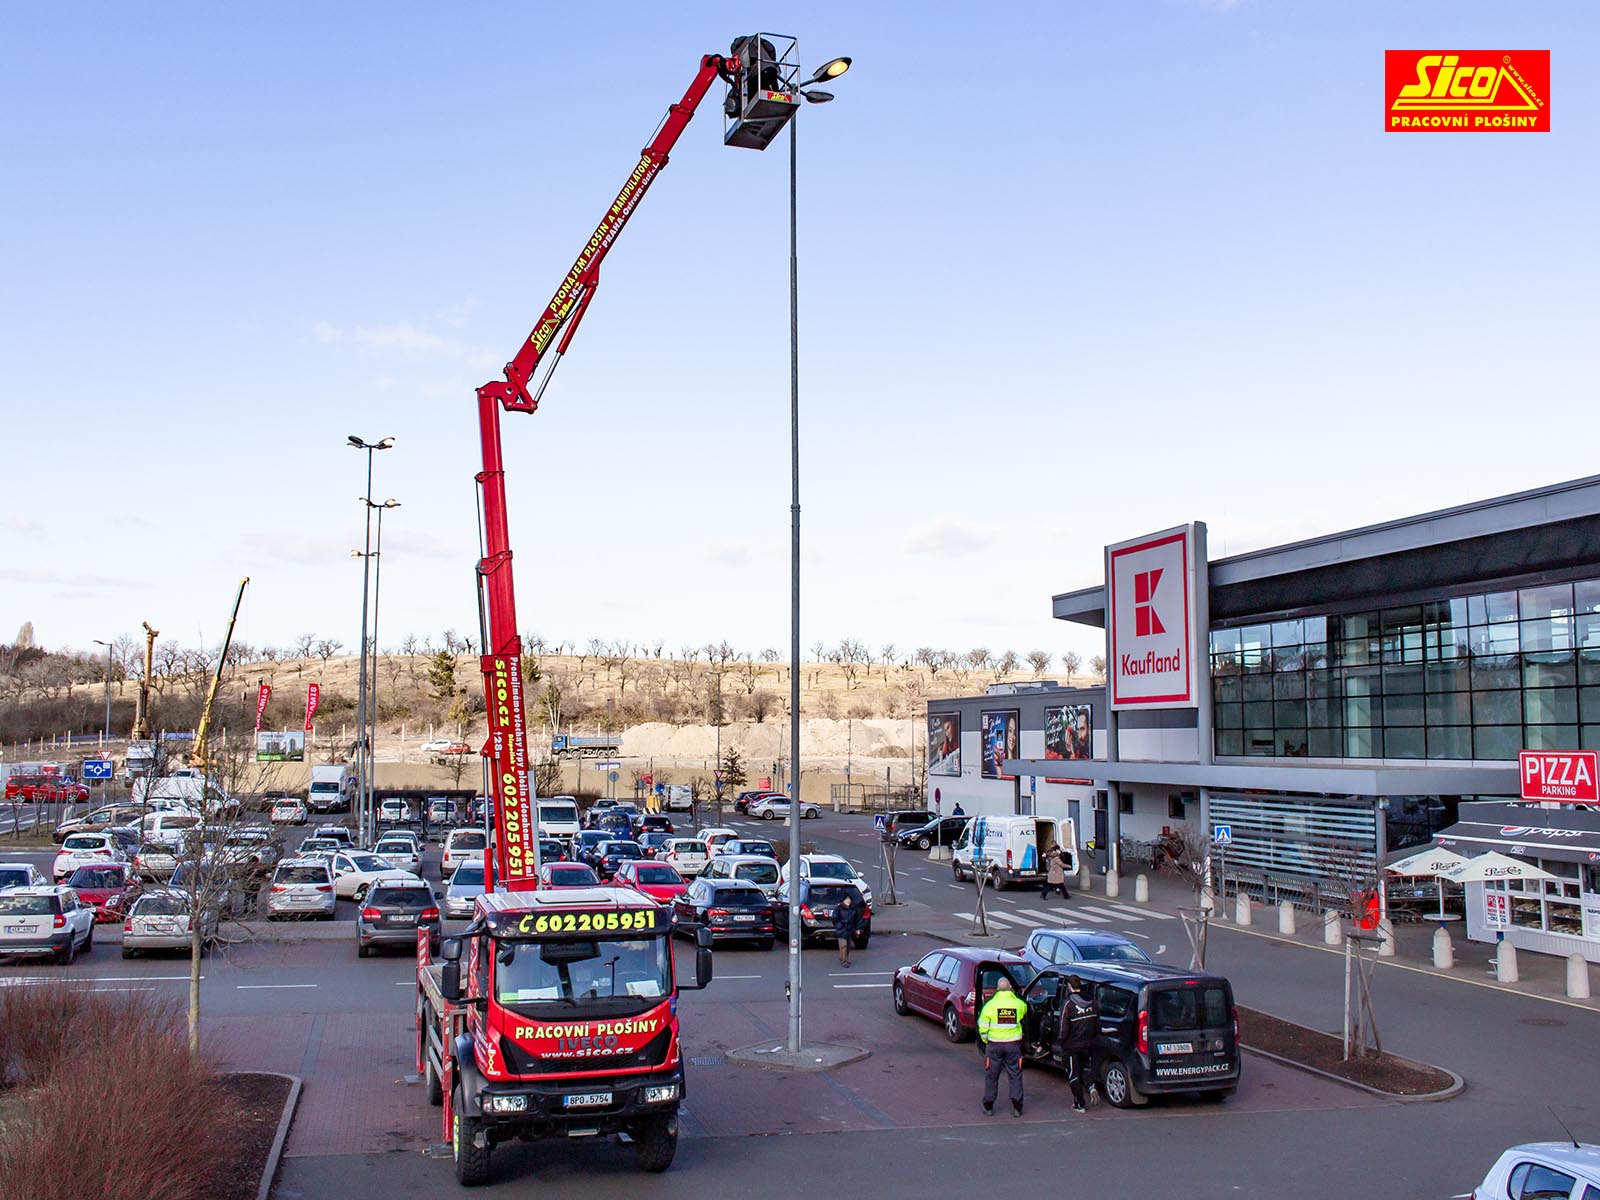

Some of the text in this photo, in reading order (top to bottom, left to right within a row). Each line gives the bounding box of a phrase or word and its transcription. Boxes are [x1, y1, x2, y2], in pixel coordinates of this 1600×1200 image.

[1122, 648, 1180, 676] Kaufland
[495, 659, 510, 727] sico.cz
[514, 714, 524, 747] všechny
[516, 748, 525, 768] typy
[517, 770, 528, 797] plošin
[1525, 757, 1592, 786] PIZZA
[503, 773, 518, 807] 602
[1541, 785, 1577, 796] PARKING
[505, 810, 521, 843] 205
[521, 803, 531, 841] dosahem
[508, 845, 523, 877] 951
[524, 849, 534, 866] 48
[535, 911, 655, 933] 602205951
[515, 1019, 658, 1040] PRACOVNÍ PLOŠINY
[541, 1047, 634, 1059] www.sico.cz
[559, 1035, 618, 1051] IVECO
[1156, 1064, 1229, 1076] WWW.ENERGYPACK.CZ
[590, 1094, 609, 1104] 5754
